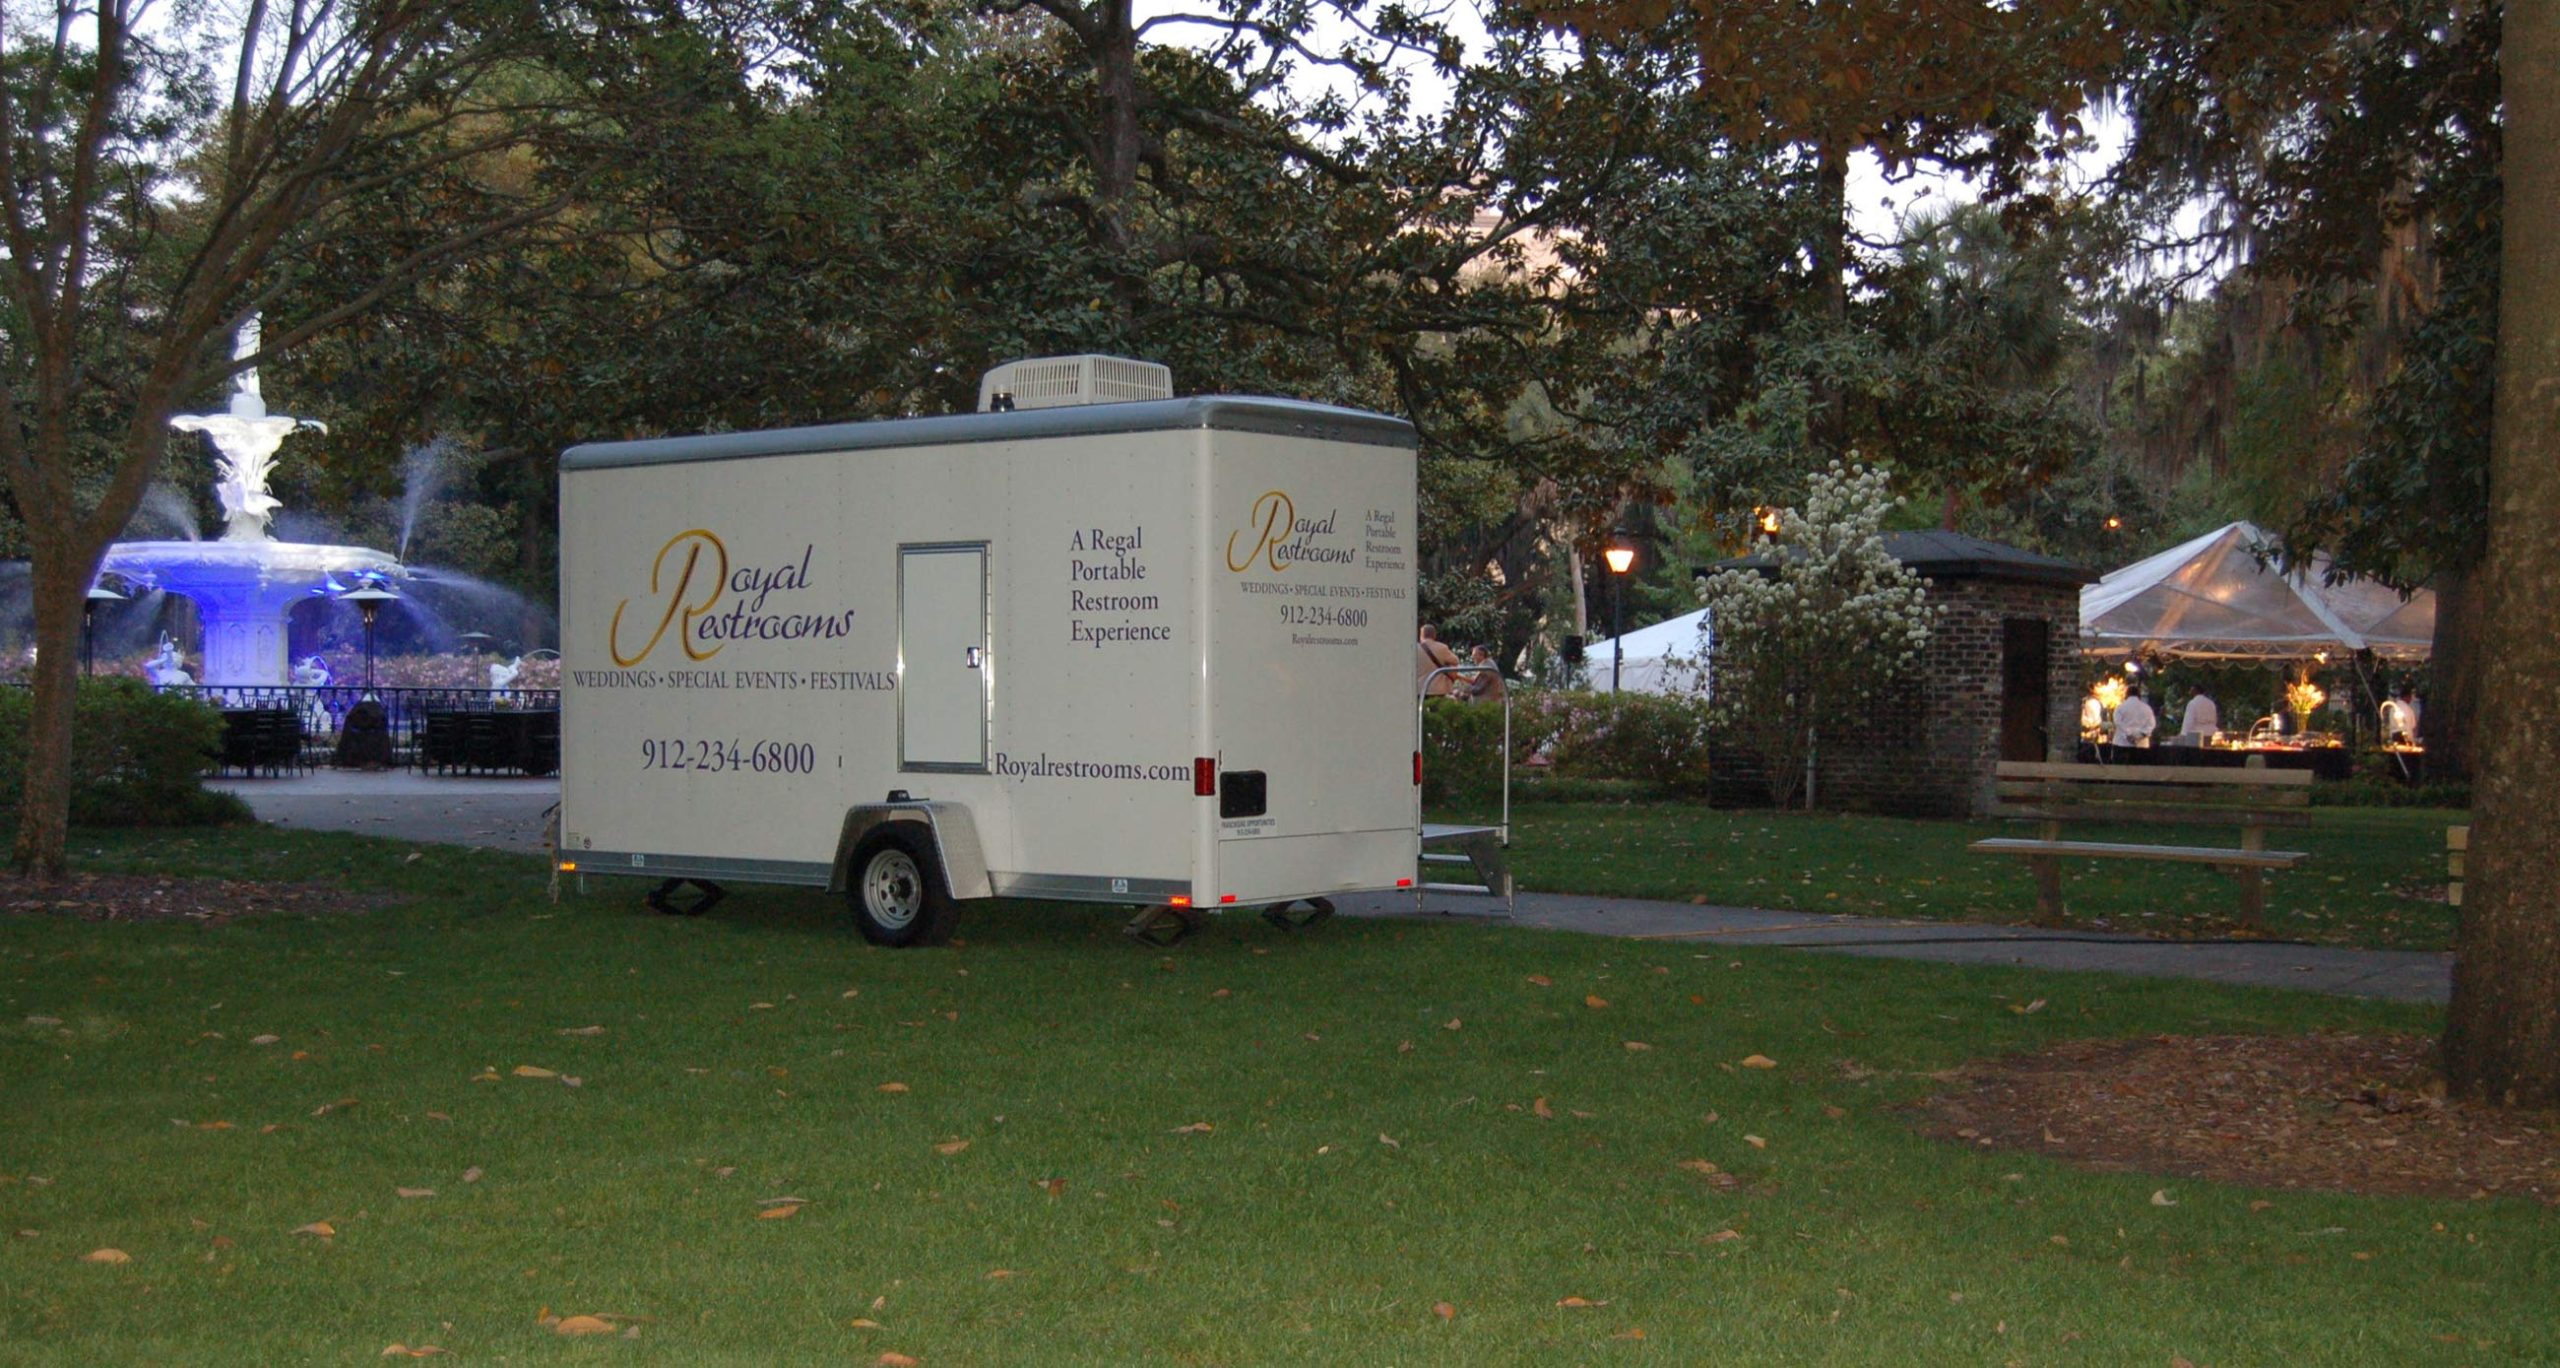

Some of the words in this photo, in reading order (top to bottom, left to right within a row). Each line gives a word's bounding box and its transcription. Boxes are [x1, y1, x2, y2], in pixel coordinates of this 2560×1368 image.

[1070, 529, 1084, 551] A
[1091, 526, 1142, 557] Regal
[1227, 491, 1337, 572] Royal
[1071, 557, 1146, 581] Portable
[609, 528, 813, 668] Royal
[1071, 590, 1159, 611] Restroom
[1241, 582, 1289, 595] WEDDINGS
[1295, 584, 1327, 596] SPECIAL
[1329, 586, 1361, 598] EVENTS
[1366, 587, 1406, 599] FESTIVALS
[1280, 604, 1368, 628] 912-234-6800
[1071, 619, 1171, 648] Experience
[573, 670, 656, 689] WEDDINGS
[667, 671, 729, 689] SPECIAL
[736, 671, 797, 690] EVENTS
[810, 672, 896, 691] FESTIVALS
[642, 738, 815, 773] 912-234-6800
[995, 752, 1192, 783] Royalrestrooms.com
